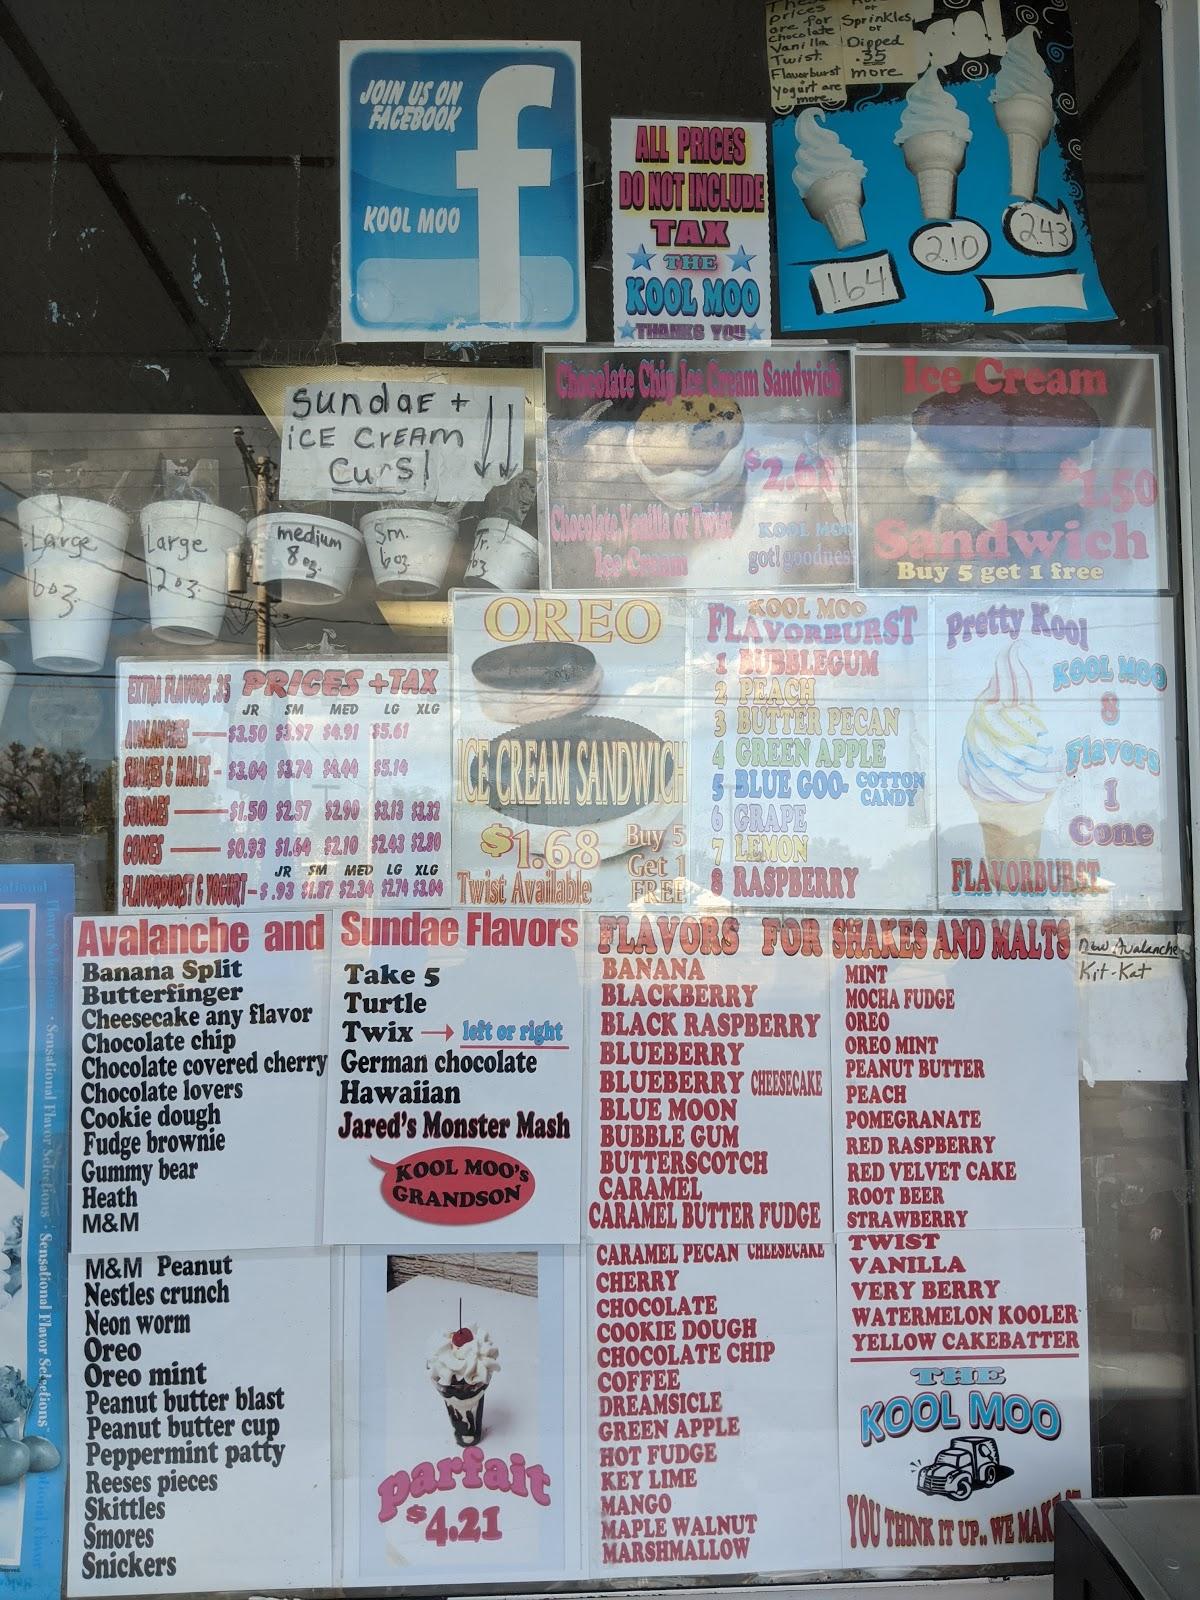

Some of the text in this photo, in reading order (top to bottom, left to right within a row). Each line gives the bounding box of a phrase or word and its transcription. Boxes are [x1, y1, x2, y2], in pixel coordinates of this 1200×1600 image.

[769, 15, 832, 34] are for
[770, 3, 826, 25] prices
[847, 35, 904, 49] Dipped
[771, 66, 841, 80] Flavorburst
[851, 67, 903, 78] more
[360, 80, 463, 106] JOIN US ON
[369, 105, 463, 132] FACEBOOK
[635, 125, 746, 165] ALL PRICES
[619, 172, 765, 213] DO NOT INCLUDE
[363, 206, 460, 234] KOOL MOO
[650, 219, 730, 248] TAX
[663, 254, 717, 271] THE
[625, 277, 761, 318] KOOL MOO
[635, 323, 747, 341] THANKS YOU
[556, 360, 636, 400] Chocolate
[706, 359, 760, 396] Cream
[762, 360, 844, 398] Sandwich
[904, 358, 1108, 397] Ice Cream
[31, 525, 98, 558] Large
[148, 525, 207, 560] Large
[873, 520, 1150, 563] Sandwich
[896, 562, 1104, 585] Buy 5 get 1 free
[484, 597, 663, 645] OREO
[707, 603, 918, 646] FLAVORBURST
[945, 602, 1090, 651] Pretty Kool
[242, 669, 364, 698] PRICES
[738, 678, 816, 706] PEACH
[242, 704, 440, 716] JR SM MED LG XLG
[736, 706, 900, 737] BUTTER PECAN
[228, 722, 409, 744] $3.50 $3.97 $4.91 $5.61
[735, 739, 887, 768] GREEN APPLE
[1064, 735, 1161, 777] Flavors
[456, 738, 688, 807] ICE CREAM SANDWICH
[228, 800, 360, 822] $1.50 $2.57 $2.90
[733, 804, 808, 832] GRAPE
[1068, 815, 1155, 848] Cone
[227, 835, 358, 859] $0.93 $1.64 $2.10
[479, 824, 601, 870] $1.68
[734, 834, 809, 863] LEMON
[456, 870, 592, 905] Twist Available
[732, 867, 860, 899] RASPBERRY
[951, 859, 1102, 896] FLAVORBURST
[78, 914, 325, 957] Avalanche and
[341, 910, 579, 947] Sundae Flavors
[598, 915, 1071, 960] FLAVORS FOR SHAKES AND MALTS
[82, 959, 243, 983] Banana Split
[344, 963, 440, 988] Take 5
[602, 957, 706, 980] BANANA
[845, 965, 888, 984] MINT
[81, 983, 244, 1007] Butterfinger
[344, 991, 427, 1014] Turtle
[601, 983, 758, 1007] BLACKBERRY
[81, 1003, 313, 1030] Cheesecake any flavor
[845, 1012, 890, 1032] OREO
[462, 1020, 563, 1045] left or right
[81, 1050, 328, 1080] Chocolate covered cherry
[600, 1042, 745, 1066] BLUEBERRY
[340, 1079, 461, 1105] Hawaiian
[845, 1110, 981, 1129] POMEGRANATE
[600, 1150, 769, 1175] BUTTERSCOTCH
[82, 1185, 138, 1209] Heath
[392, 1184, 522, 1208] GRANDSON
[848, 1187, 944, 1205] ROOT BEER
[849, 1256, 967, 1274] VANILLA
[85, 1279, 230, 1307] Nestles crunch
[596, 1270, 680, 1293] CHERRY
[596, 1295, 718, 1319] CHOCOLATE
[852, 1304, 1079, 1327] WATERMELON KOOLER
[85, 1310, 191, 1336] Neon worm
[598, 1368, 681, 1393] COFFEE
[910, 1366, 1007, 1386] THE
[860, 1390, 1062, 1448] KOOL MOO
[378, 1446, 551, 1523] parfait
[600, 1468, 698, 1491] KEY LIME
[84, 1495, 166, 1521] Skittles
[600, 1493, 672, 1516] MANGO
[406, 1504, 502, 1547] $4.21
[81, 1551, 177, 1580] Snickers
